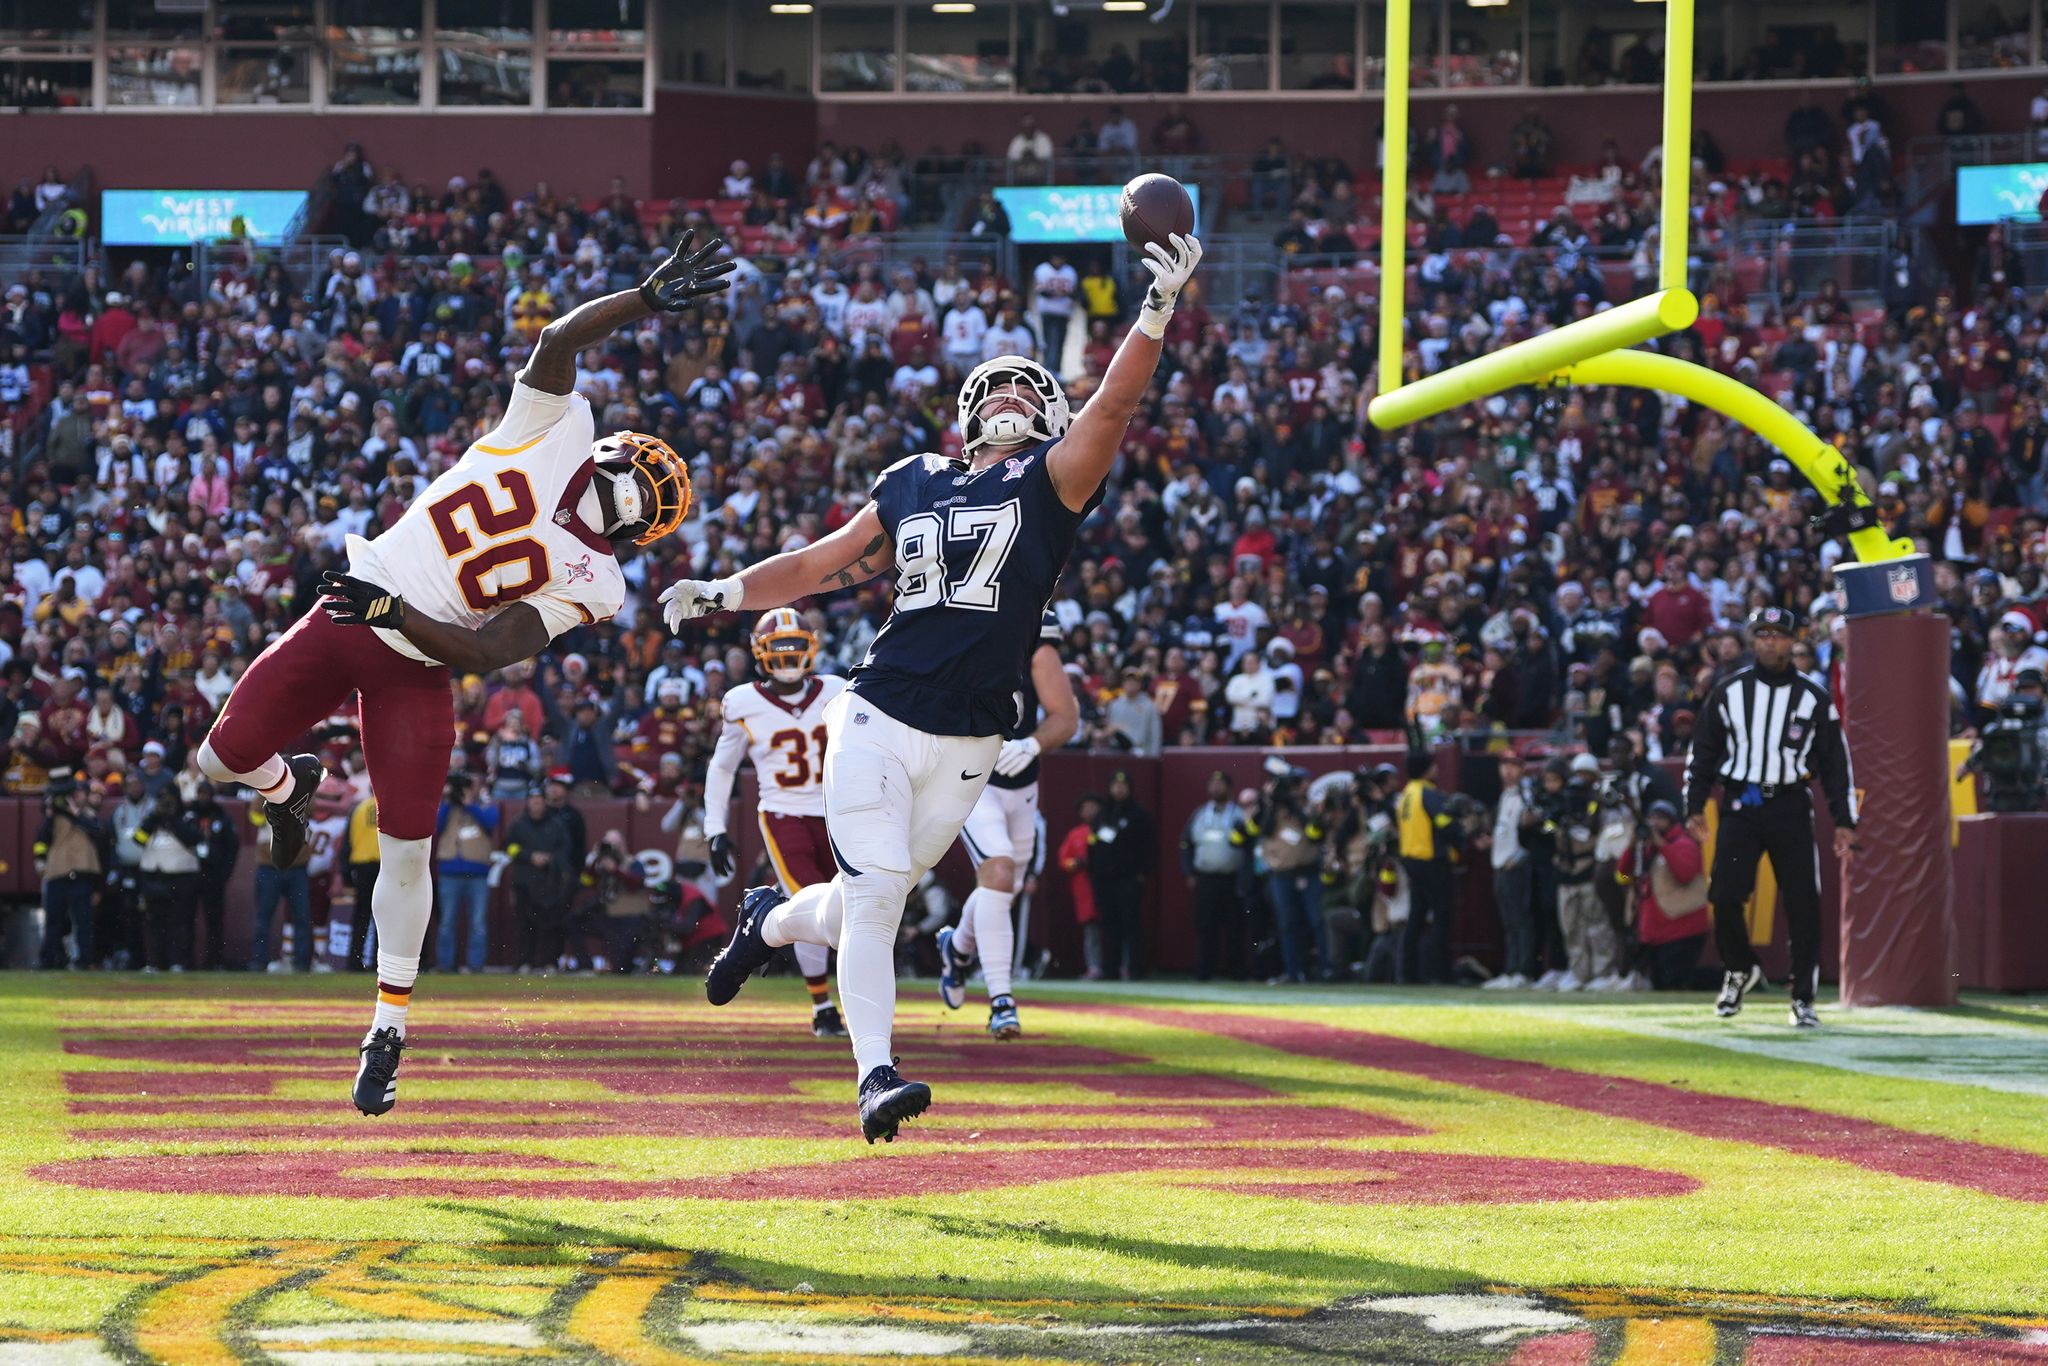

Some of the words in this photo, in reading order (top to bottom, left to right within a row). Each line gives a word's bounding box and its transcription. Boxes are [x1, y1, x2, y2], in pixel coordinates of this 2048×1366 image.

[161, 196, 236, 217] WEST
[426, 468, 552, 613] 20
[893, 497, 1022, 614] 87
[769, 723, 829, 789] 31
